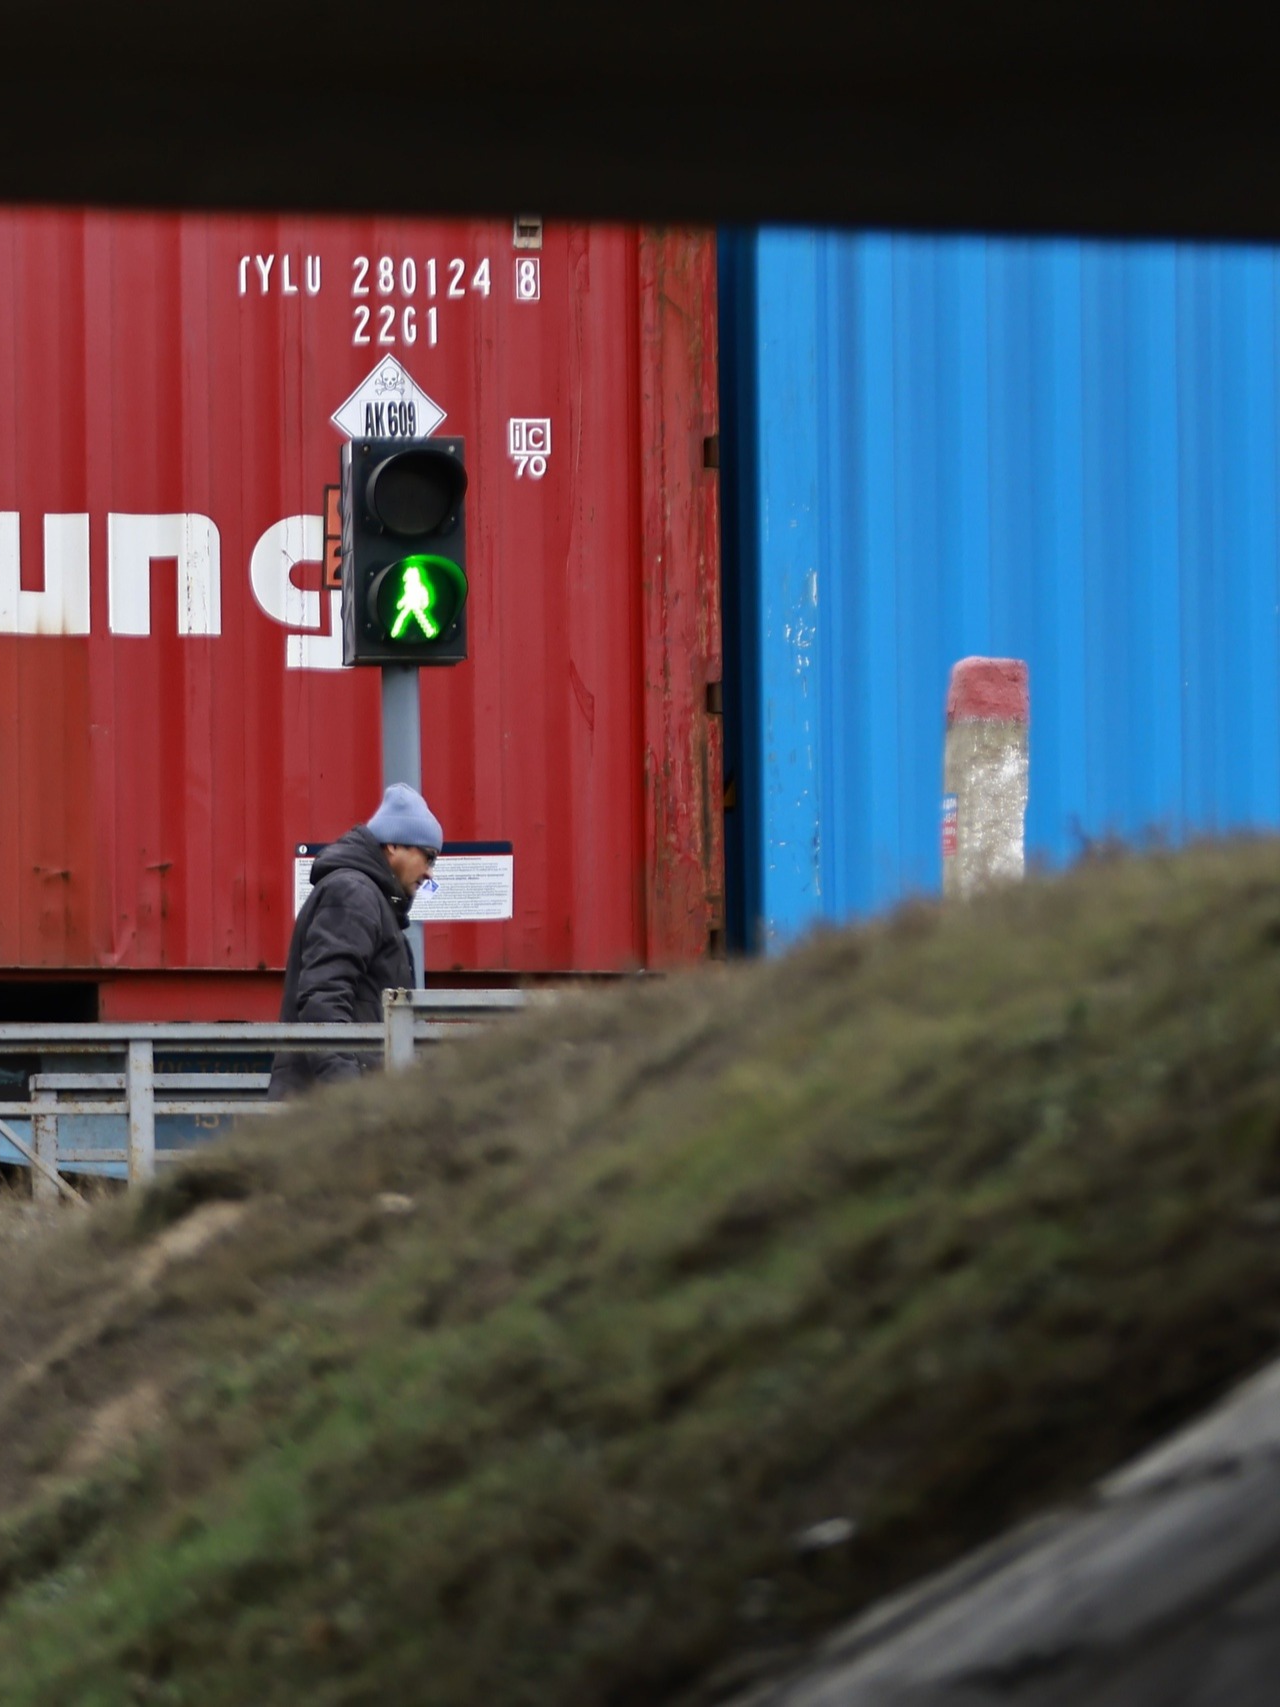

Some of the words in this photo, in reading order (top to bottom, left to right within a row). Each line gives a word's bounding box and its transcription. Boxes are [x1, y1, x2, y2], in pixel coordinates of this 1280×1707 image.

[352, 256, 492, 297] 280124
[518, 260, 538, 298] 8
[353, 304, 439, 345] 22G1
[514, 455, 547, 477] 70
